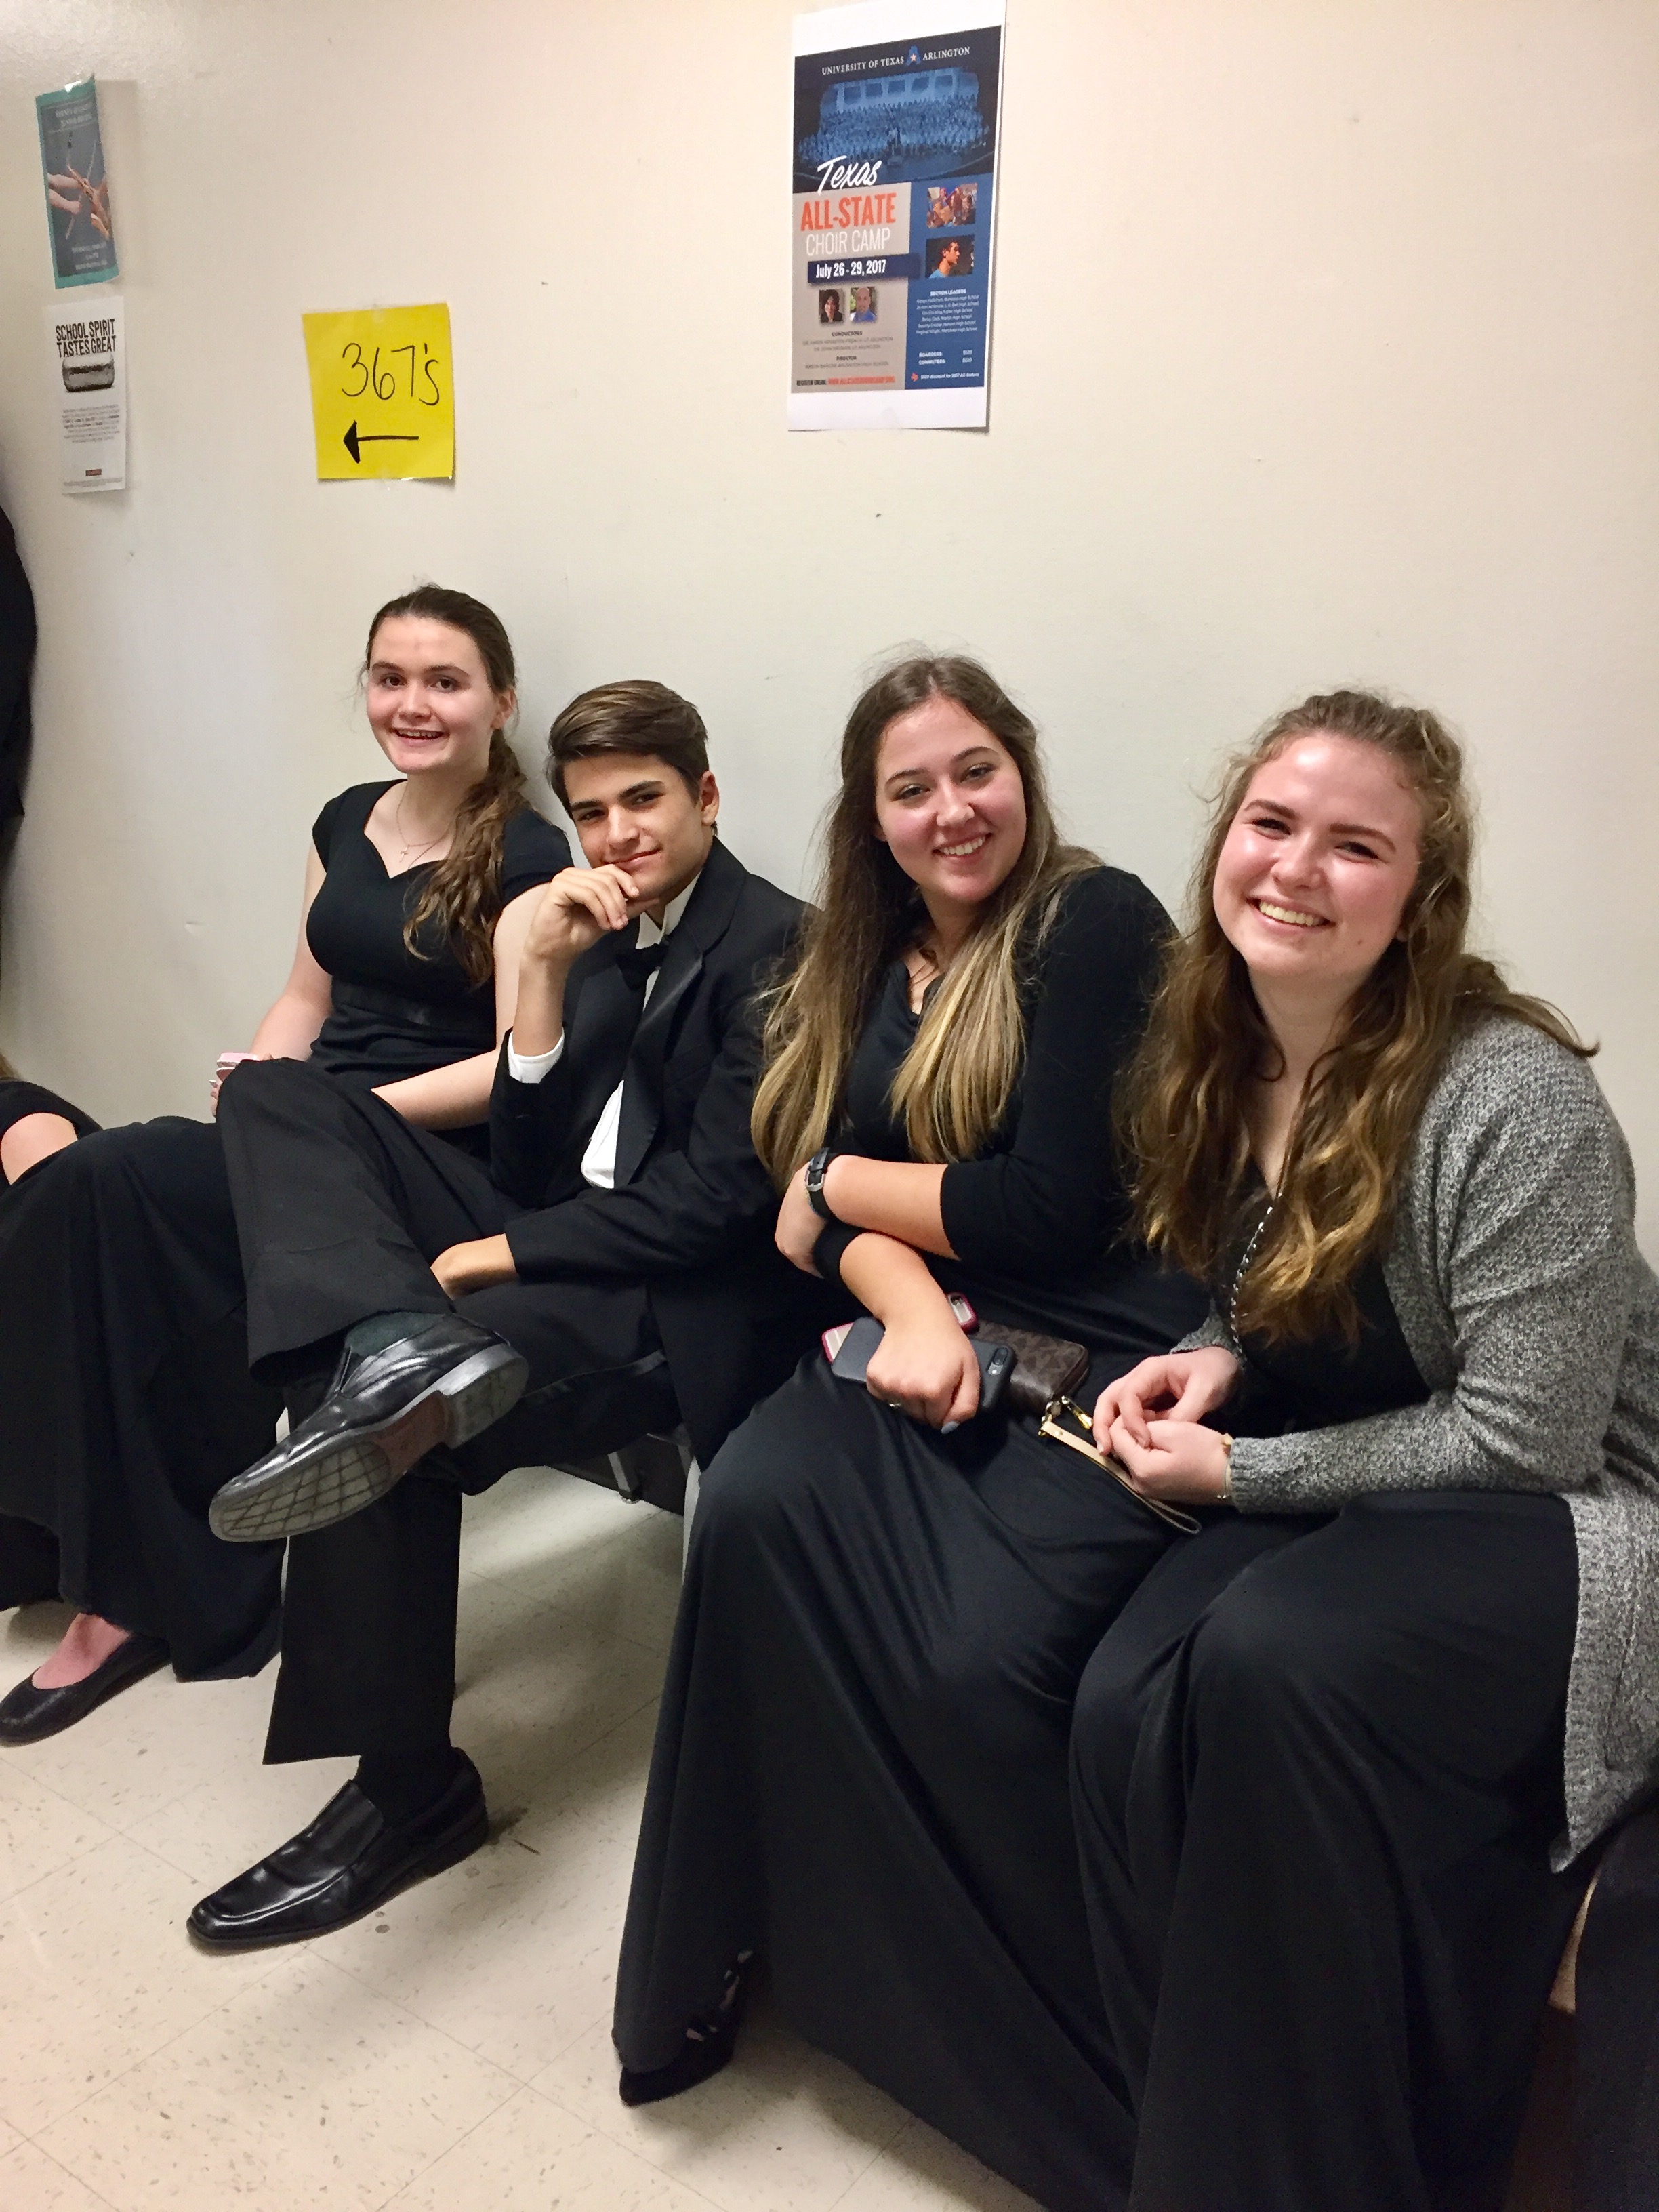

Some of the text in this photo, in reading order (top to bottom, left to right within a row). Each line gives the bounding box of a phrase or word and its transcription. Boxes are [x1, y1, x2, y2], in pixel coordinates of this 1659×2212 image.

[822, 62, 867, 75] UNIVERSITY
[868, 60, 879, 68] OF
[880, 56, 905, 66] TEXAS
[922, 46, 970, 61] ARLINGTON
[817, 157, 882, 196] Texas
[800, 192, 897, 231] ALL-STATE
[806, 228, 890, 256] CHOIR CAMP
[815, 263, 832, 279] July
[833, 262, 845, 277] 26
[851, 261, 865, 276] 29,
[866, 259, 887, 274] 2017
[56, 319, 115, 341] SCHOOL SPIRIT
[56, 335, 117, 358] TASTES GREAT
[341, 342, 441, 406] 367's
